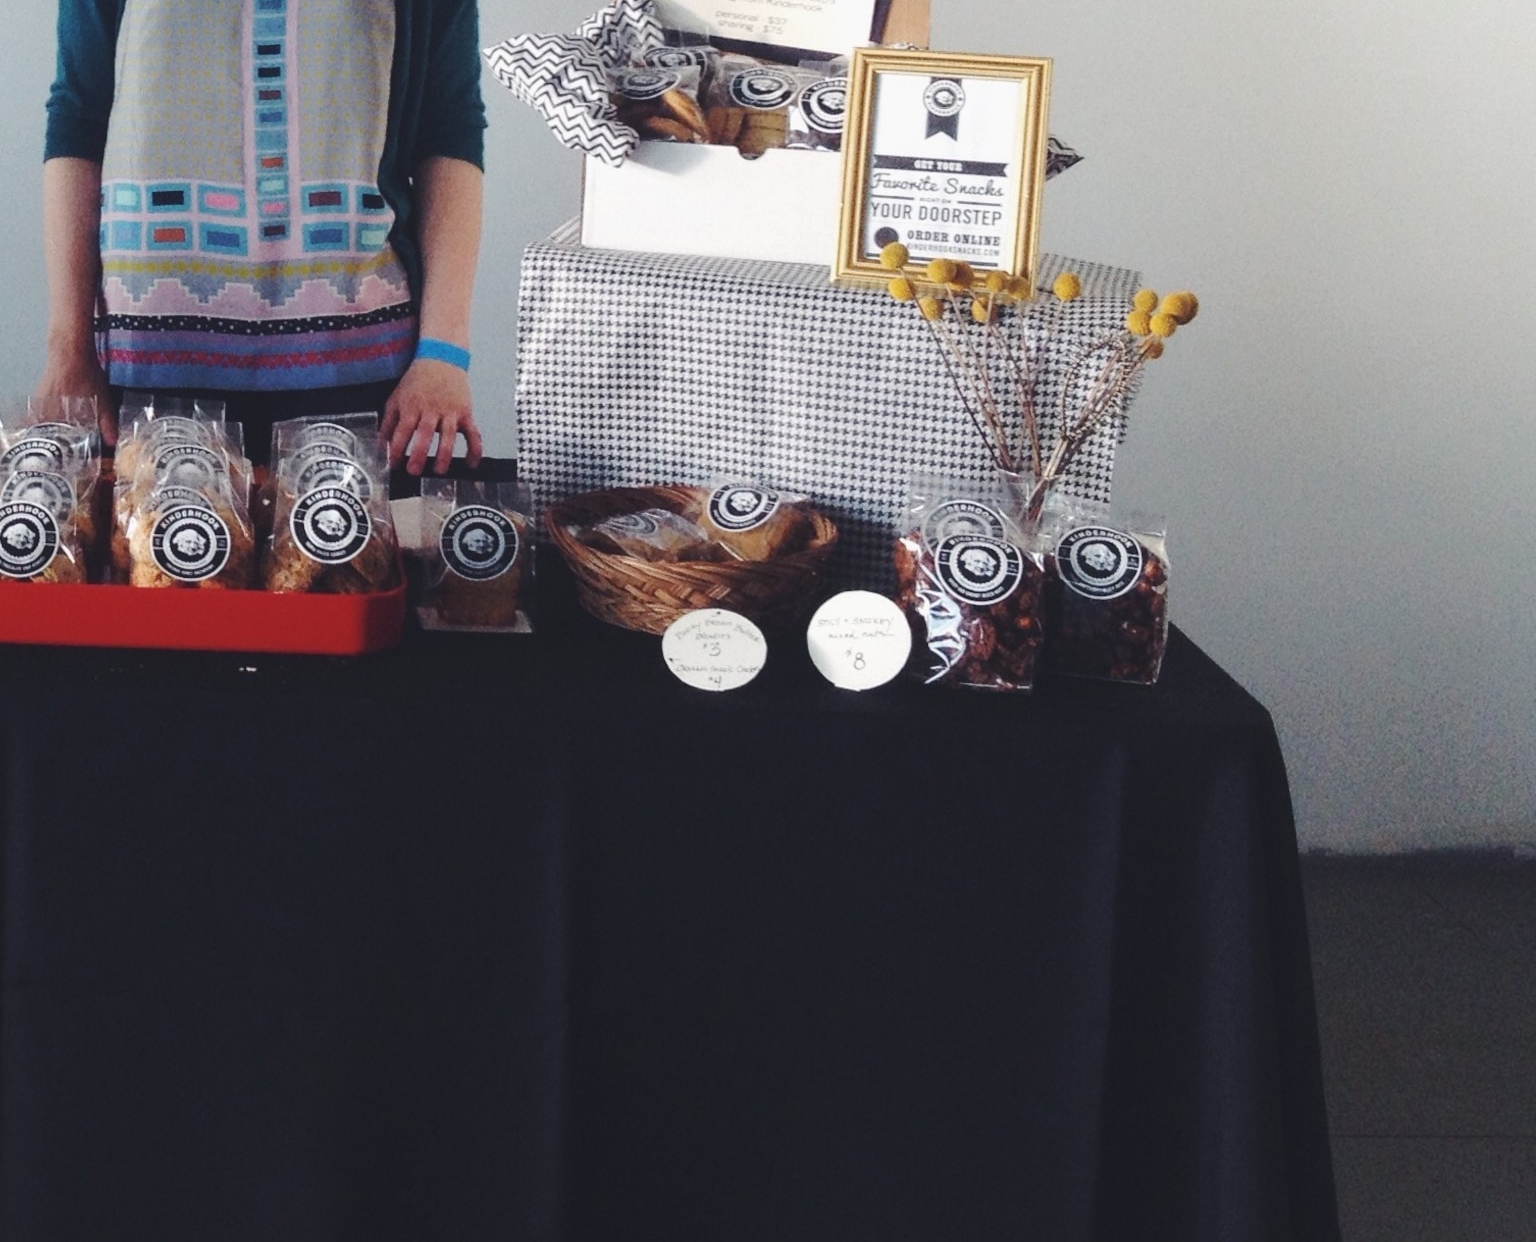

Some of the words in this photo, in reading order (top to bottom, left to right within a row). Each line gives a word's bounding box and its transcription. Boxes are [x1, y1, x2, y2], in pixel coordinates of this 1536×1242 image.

[914, 159, 934, 169] GET
[936, 161, 963, 172] YOUR
[870, 173, 940, 192] Favorite
[944, 178, 1004, 196] Snacks
[871, 201, 912, 219] YOUR
[919, 205, 1002, 226] DOORSTEP
[907, 230, 949, 242] ORDER
[954, 234, 1001, 246] ONLINE
[305, 489, 363, 517] KINDERHOOK
[160, 509, 220, 530] KINDERHOOK
[448, 510, 506, 530] KINDERHOOK
[1068, 529, 1134, 548] KINDERHOOK
